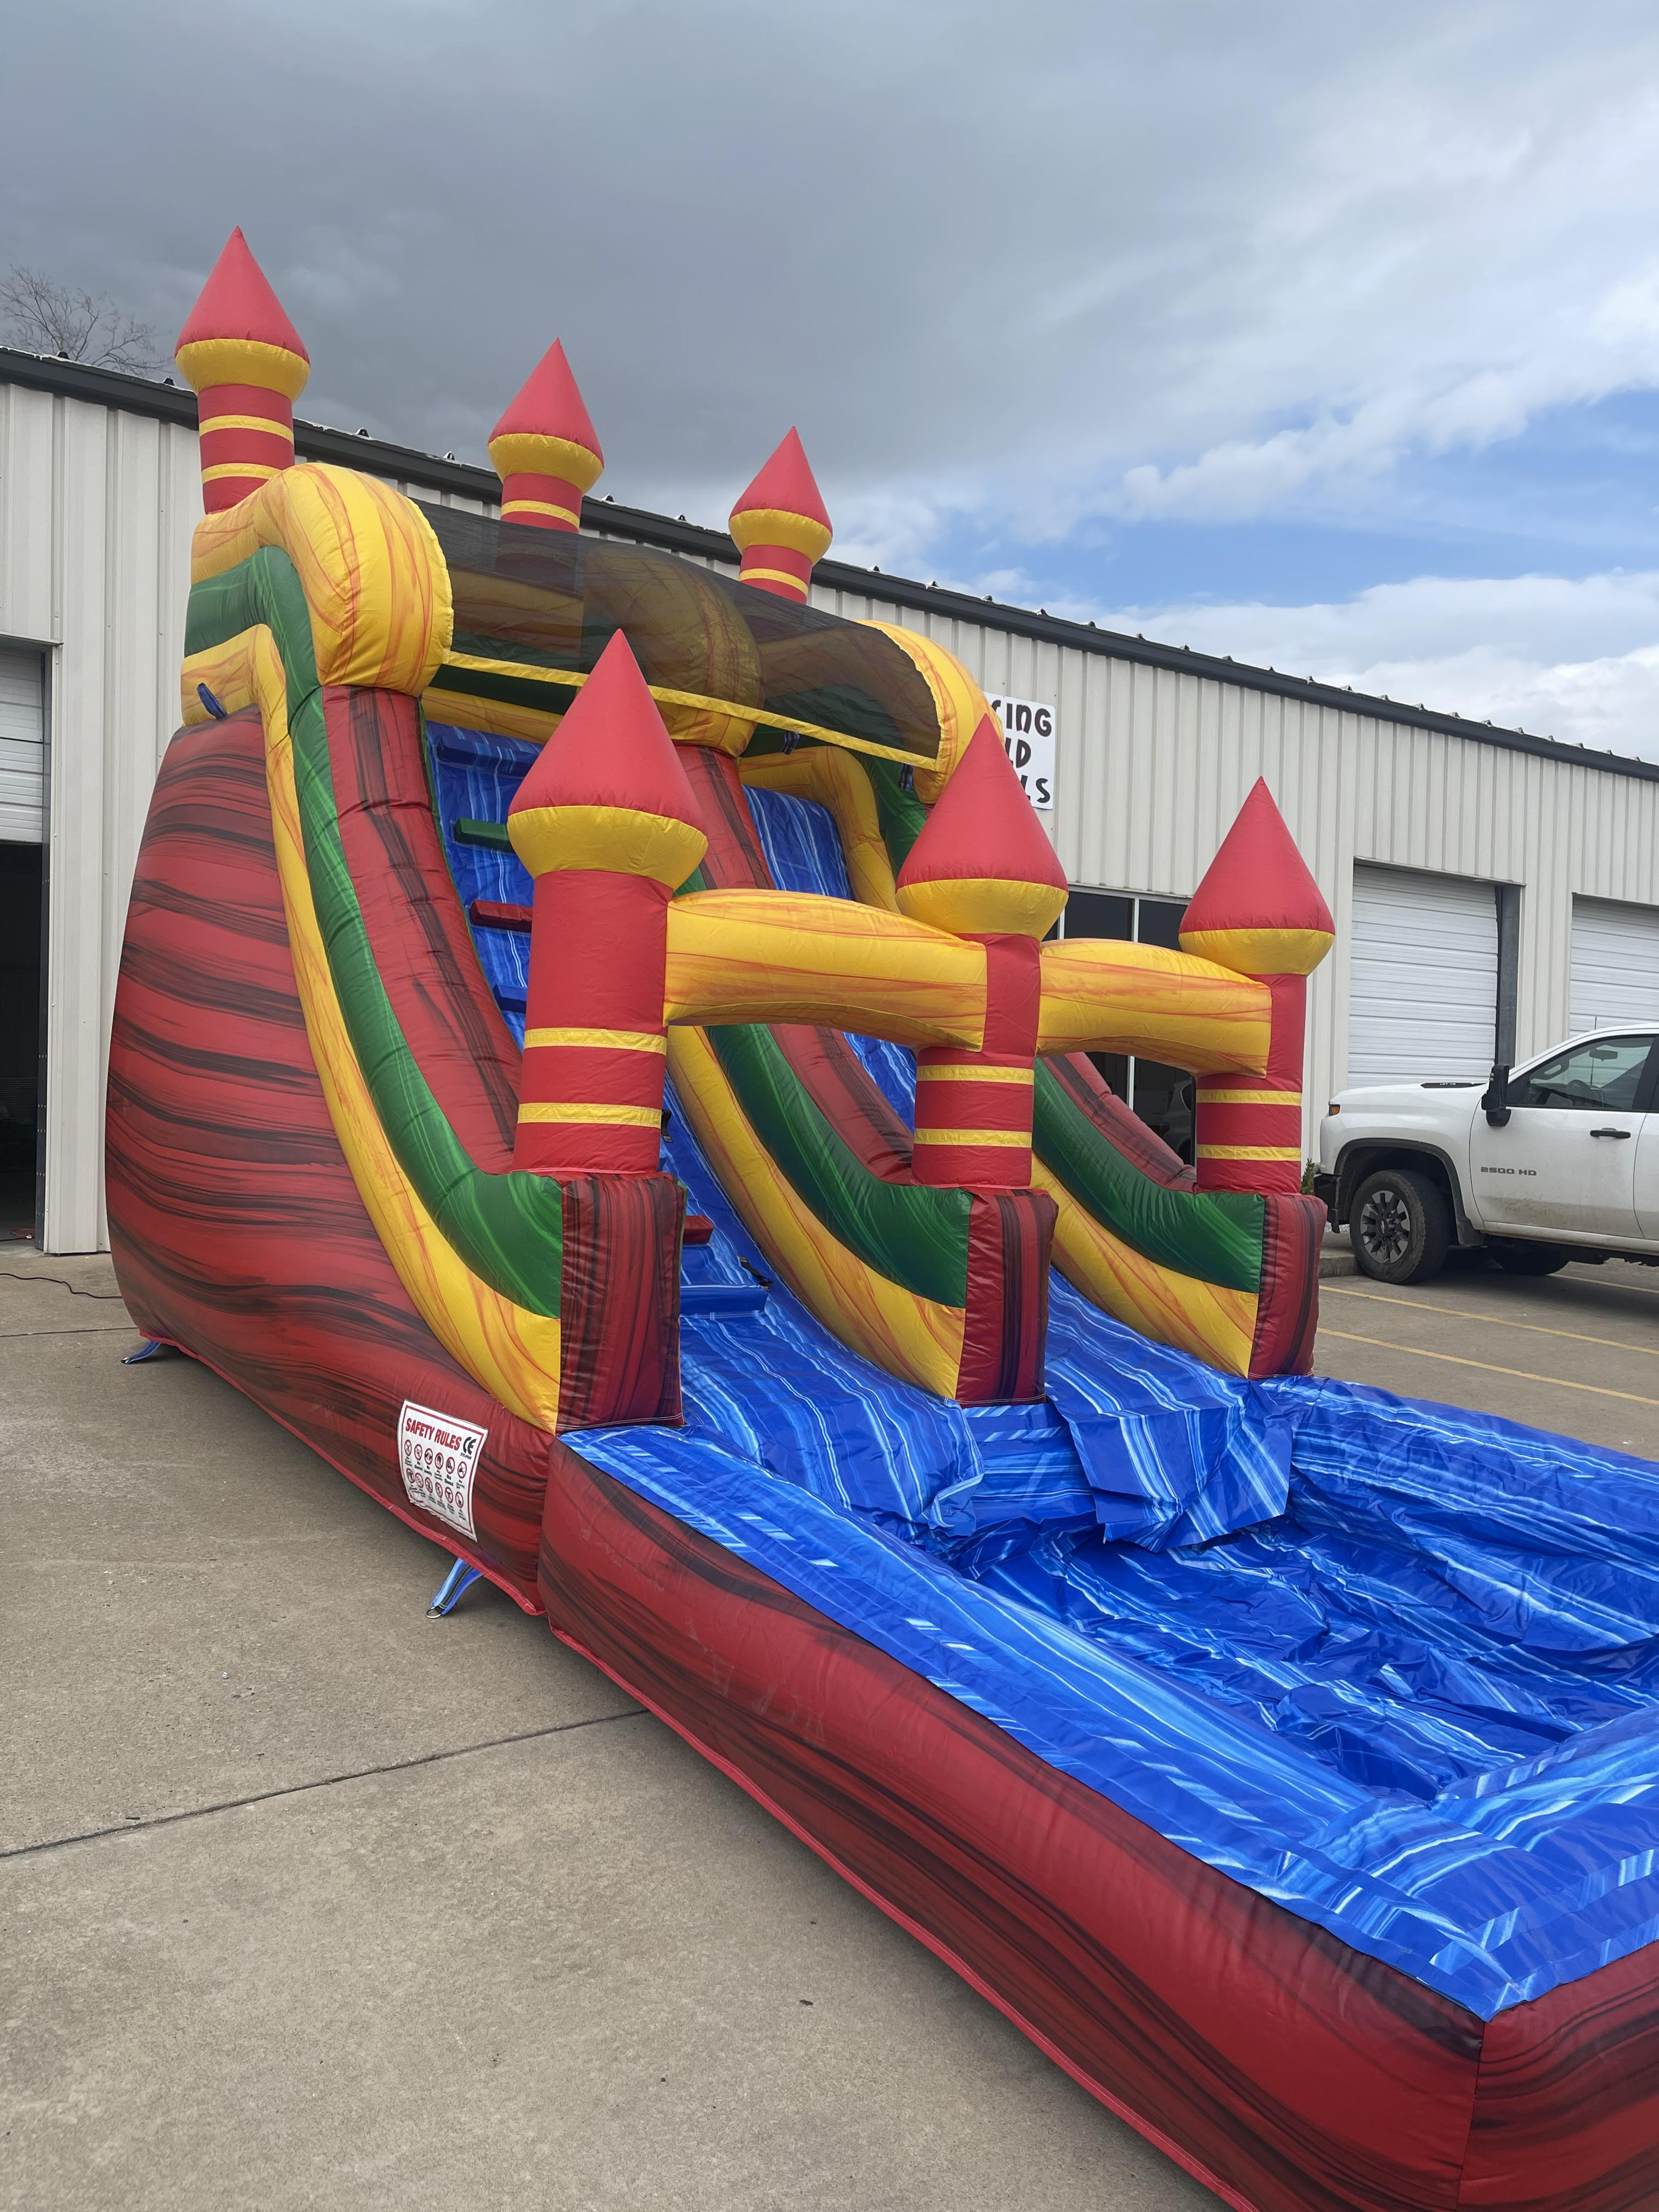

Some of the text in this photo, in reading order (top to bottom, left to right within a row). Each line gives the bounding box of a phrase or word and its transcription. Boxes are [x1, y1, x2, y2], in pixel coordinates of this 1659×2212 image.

[1481, 1166, 1515, 1175] 2500
[405, 1418, 462, 1451] SAFETY RULES
